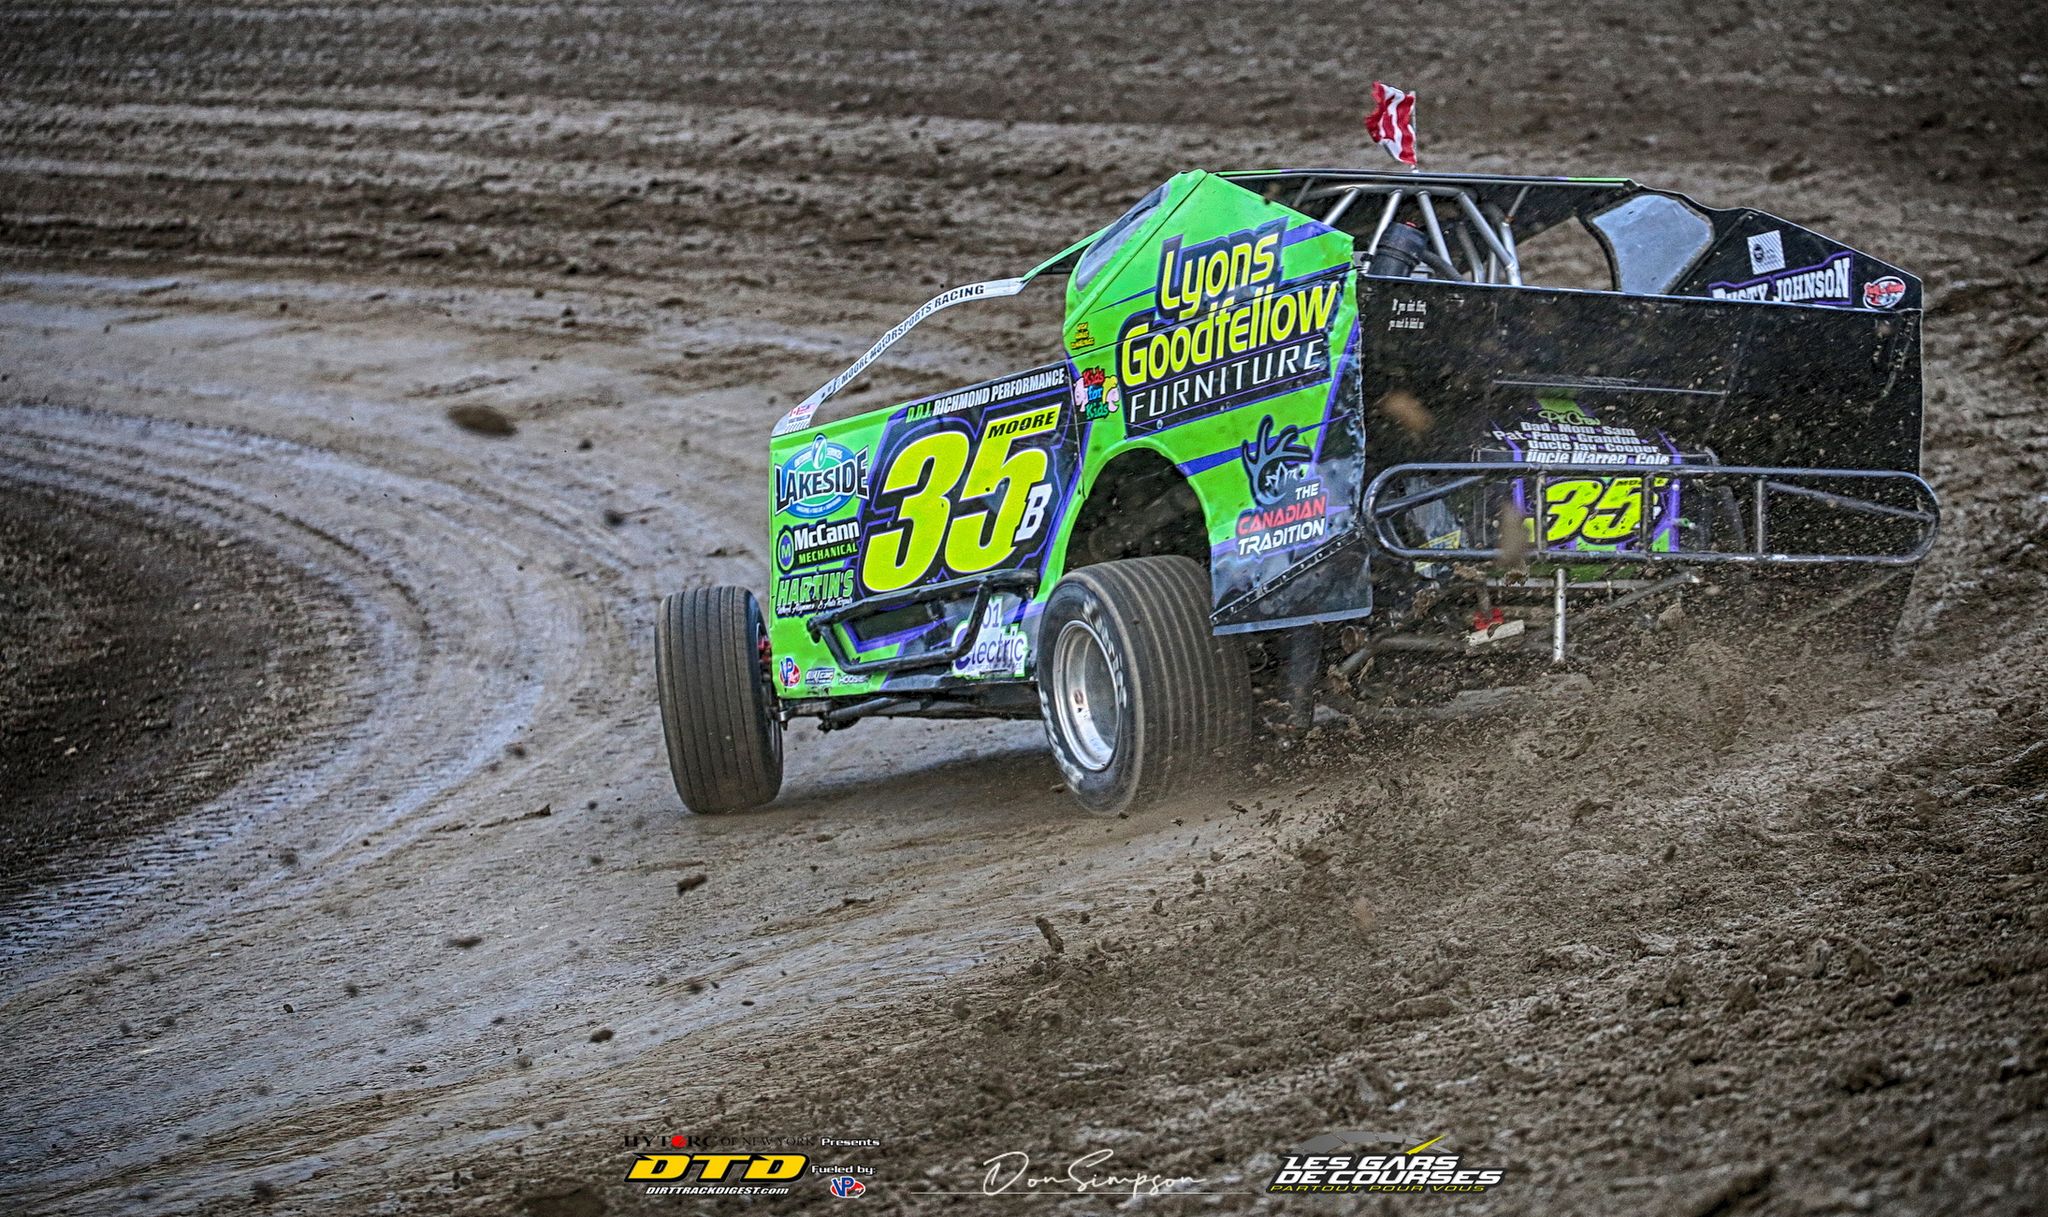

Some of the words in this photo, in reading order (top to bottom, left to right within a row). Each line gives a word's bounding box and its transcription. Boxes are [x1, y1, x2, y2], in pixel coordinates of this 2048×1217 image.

[1161, 232, 1280, 320] Lyons
[1773, 257, 1850, 302] JOHNSON
[869, 304, 933, 360] MOTORSPORTS
[934, 285, 985, 308] RACING
[1121, 281, 1340, 387] Goodfellow
[933, 387, 990, 416] RICHMOND
[991, 368, 1065, 402] PERFORMANCE
[1083, 367, 1105, 387] Kids
[1087, 384, 1103, 401] for
[1130, 338, 1325, 424] FURNITURE
[987, 411, 1056, 439] MOORE
[1085, 401, 1109, 420] Kids
[1492, 430, 1527, 440] Pat
[1531, 431, 1570, 441] Papa
[1576, 433, 1641, 444] Grandpa
[1521, 422, 1551, 432] Dad
[1557, 423, 1596, 434] Mom
[1602, 425, 1636, 436] Sam
[1525, 449, 1570, 463] Uncle
[1571, 451, 1627, 464] Warren
[1635, 453, 1670, 465] Cole
[1528, 440, 1572, 451] Uncle
[1604, 443, 1660, 454] Cooper
[775, 445, 869, 514] LAKESIDE
[1295, 483, 1319, 500] THE
[862, 404, 1062, 592] 35
[1015, 484, 1052, 542] B
[1535, 477, 1655, 542] 35
[1237, 496, 1326, 535] CANADIAN
[794, 521, 860, 551] McCann
[1238, 518, 1325, 556] TRADITION
[799, 543, 858, 564] MECHANICAL
